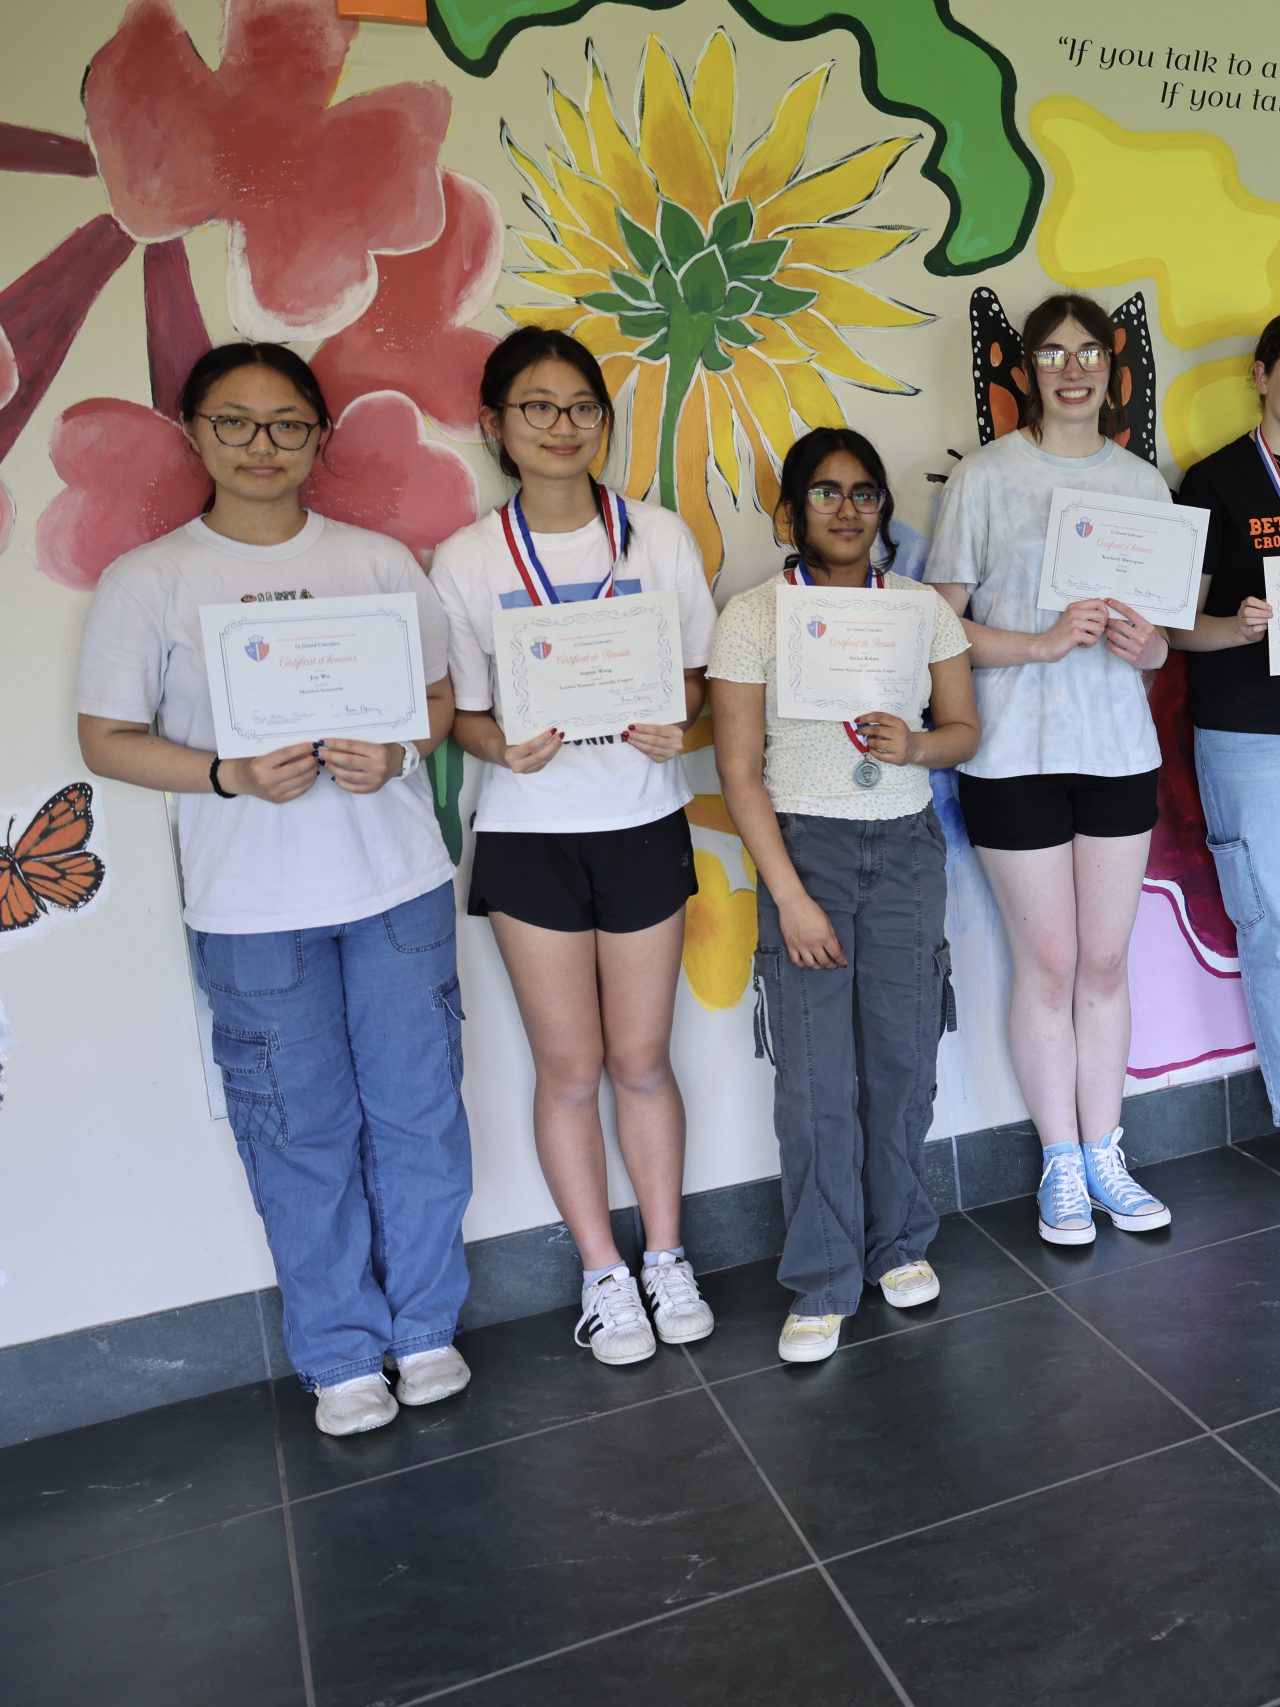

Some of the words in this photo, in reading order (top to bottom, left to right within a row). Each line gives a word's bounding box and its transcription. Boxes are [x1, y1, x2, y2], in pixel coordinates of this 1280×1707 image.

[1098, 46, 1154, 70] you
[1165, 46, 1218, 74] talk
[1227, 52, 1252, 77] to
[1261, 61, 1278, 79] a
[1160, 80, 1184, 110] If
[1189, 88, 1242, 112] you
